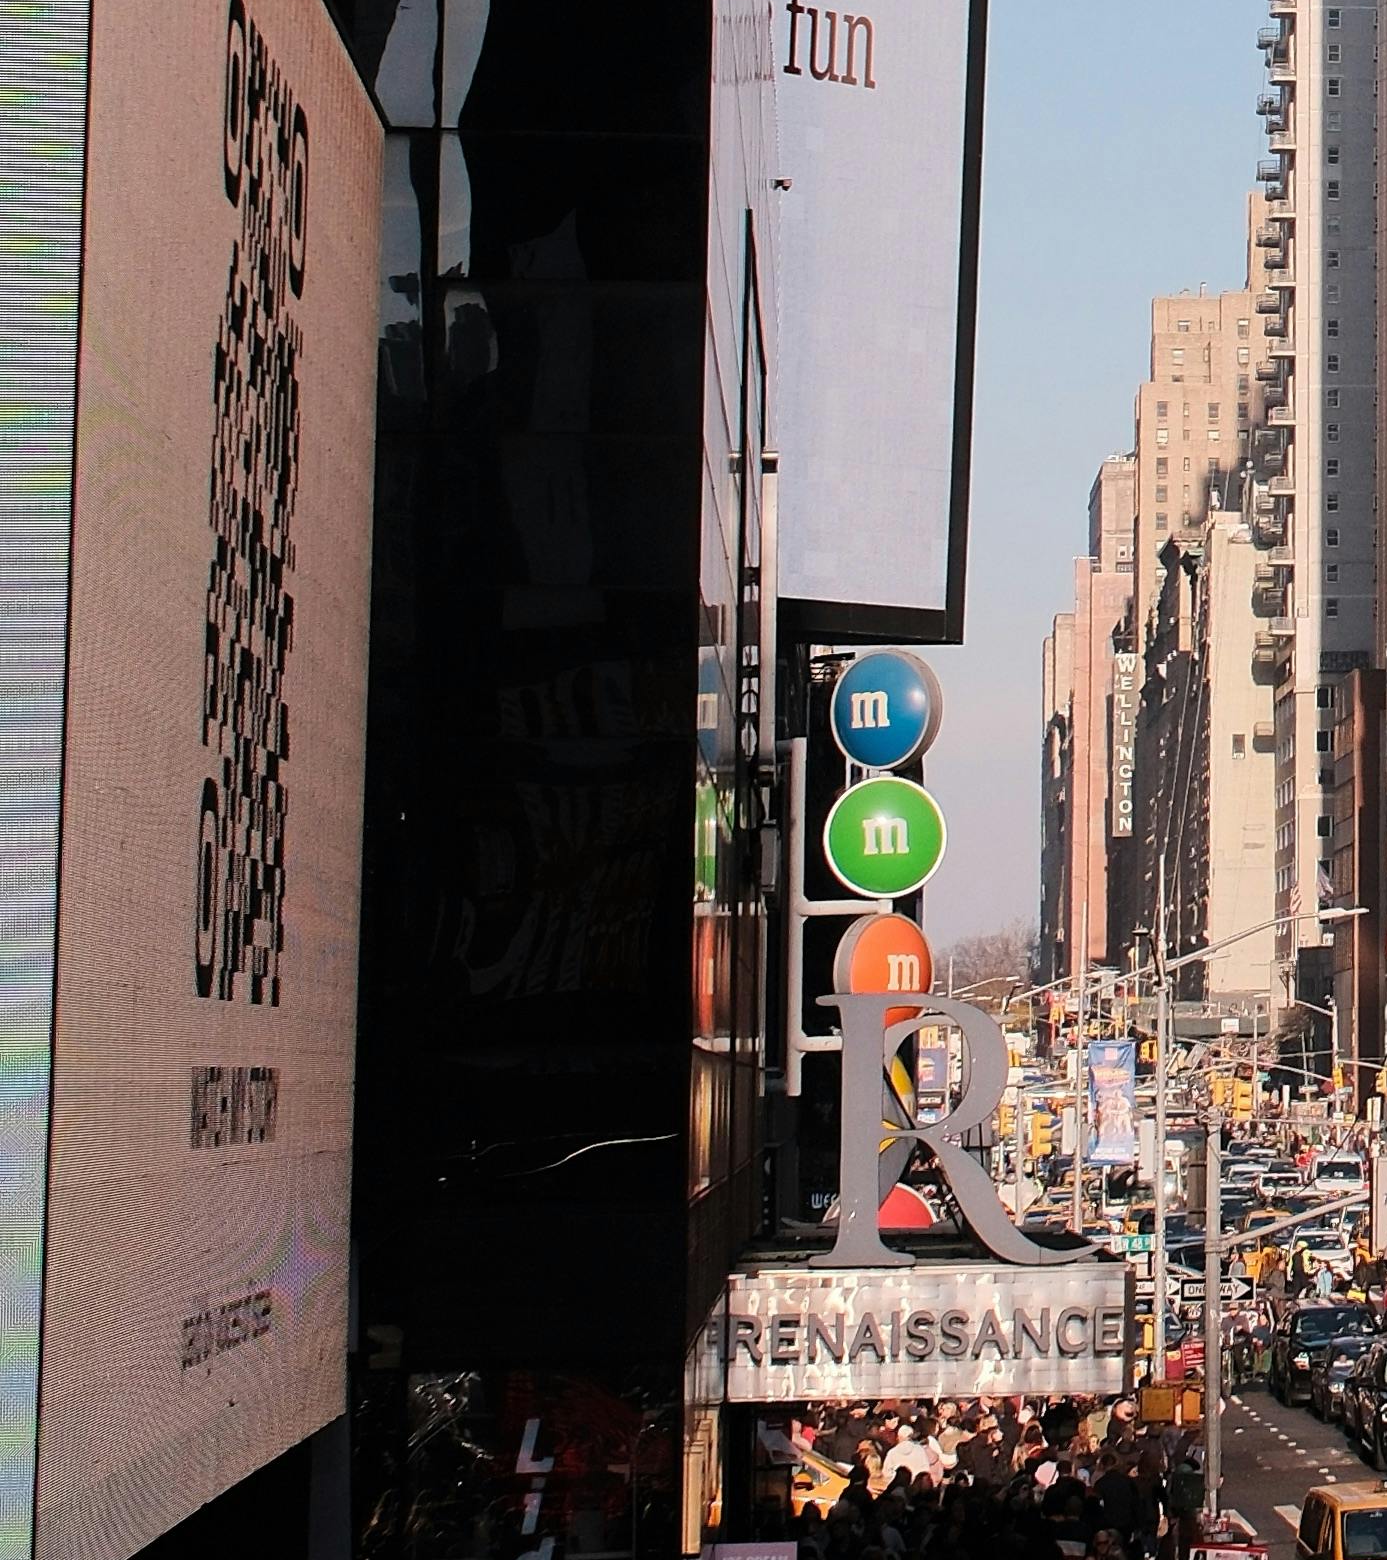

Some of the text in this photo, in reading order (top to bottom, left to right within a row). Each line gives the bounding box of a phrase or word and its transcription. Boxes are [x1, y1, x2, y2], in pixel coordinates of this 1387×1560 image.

[851, 690, 889, 728] m
[1116, 654, 1136, 832] WELLINGTON
[863, 816, 909, 856] m
[887, 953, 920, 991] m
[729, 1306, 1124, 1362] RENAISSANCE
